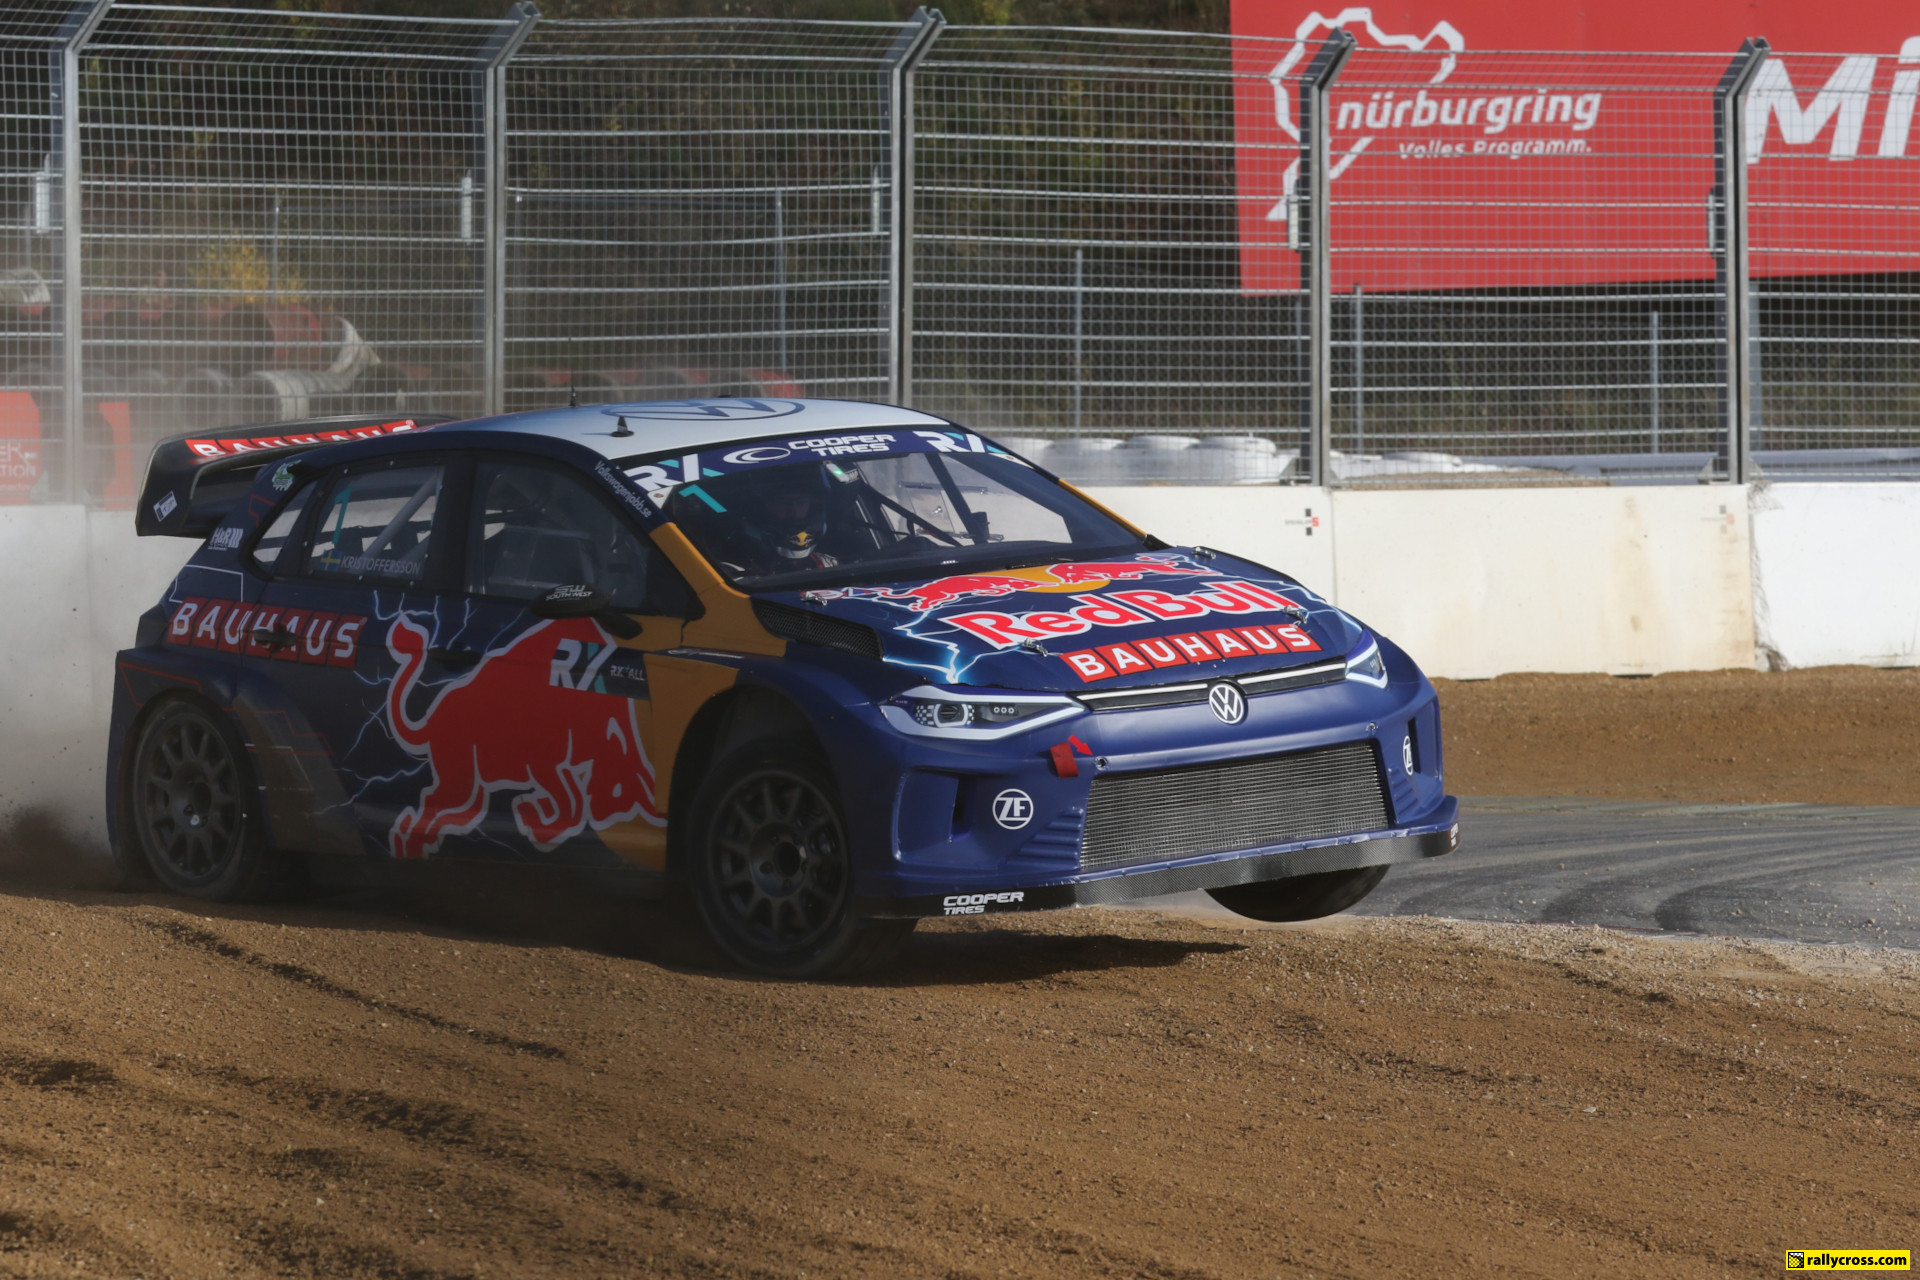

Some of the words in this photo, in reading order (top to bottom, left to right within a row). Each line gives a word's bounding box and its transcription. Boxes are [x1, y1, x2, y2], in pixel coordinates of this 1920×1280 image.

[1336, 89, 1602, 134] nürburgring
[1399, 140, 1466, 159] Volles
[1473, 138, 1593, 160] Programm.
[788, 434, 897, 451] COOPER
[811, 442, 891, 457] TIRES
[340, 555, 422, 575] KRISTOFFERSSON
[1068, 627, 1312, 677] BAUHAUS
[995, 793, 1032, 825] ZF
[943, 891, 1024, 906] COOPER
[943, 905, 985, 915] TIRES
